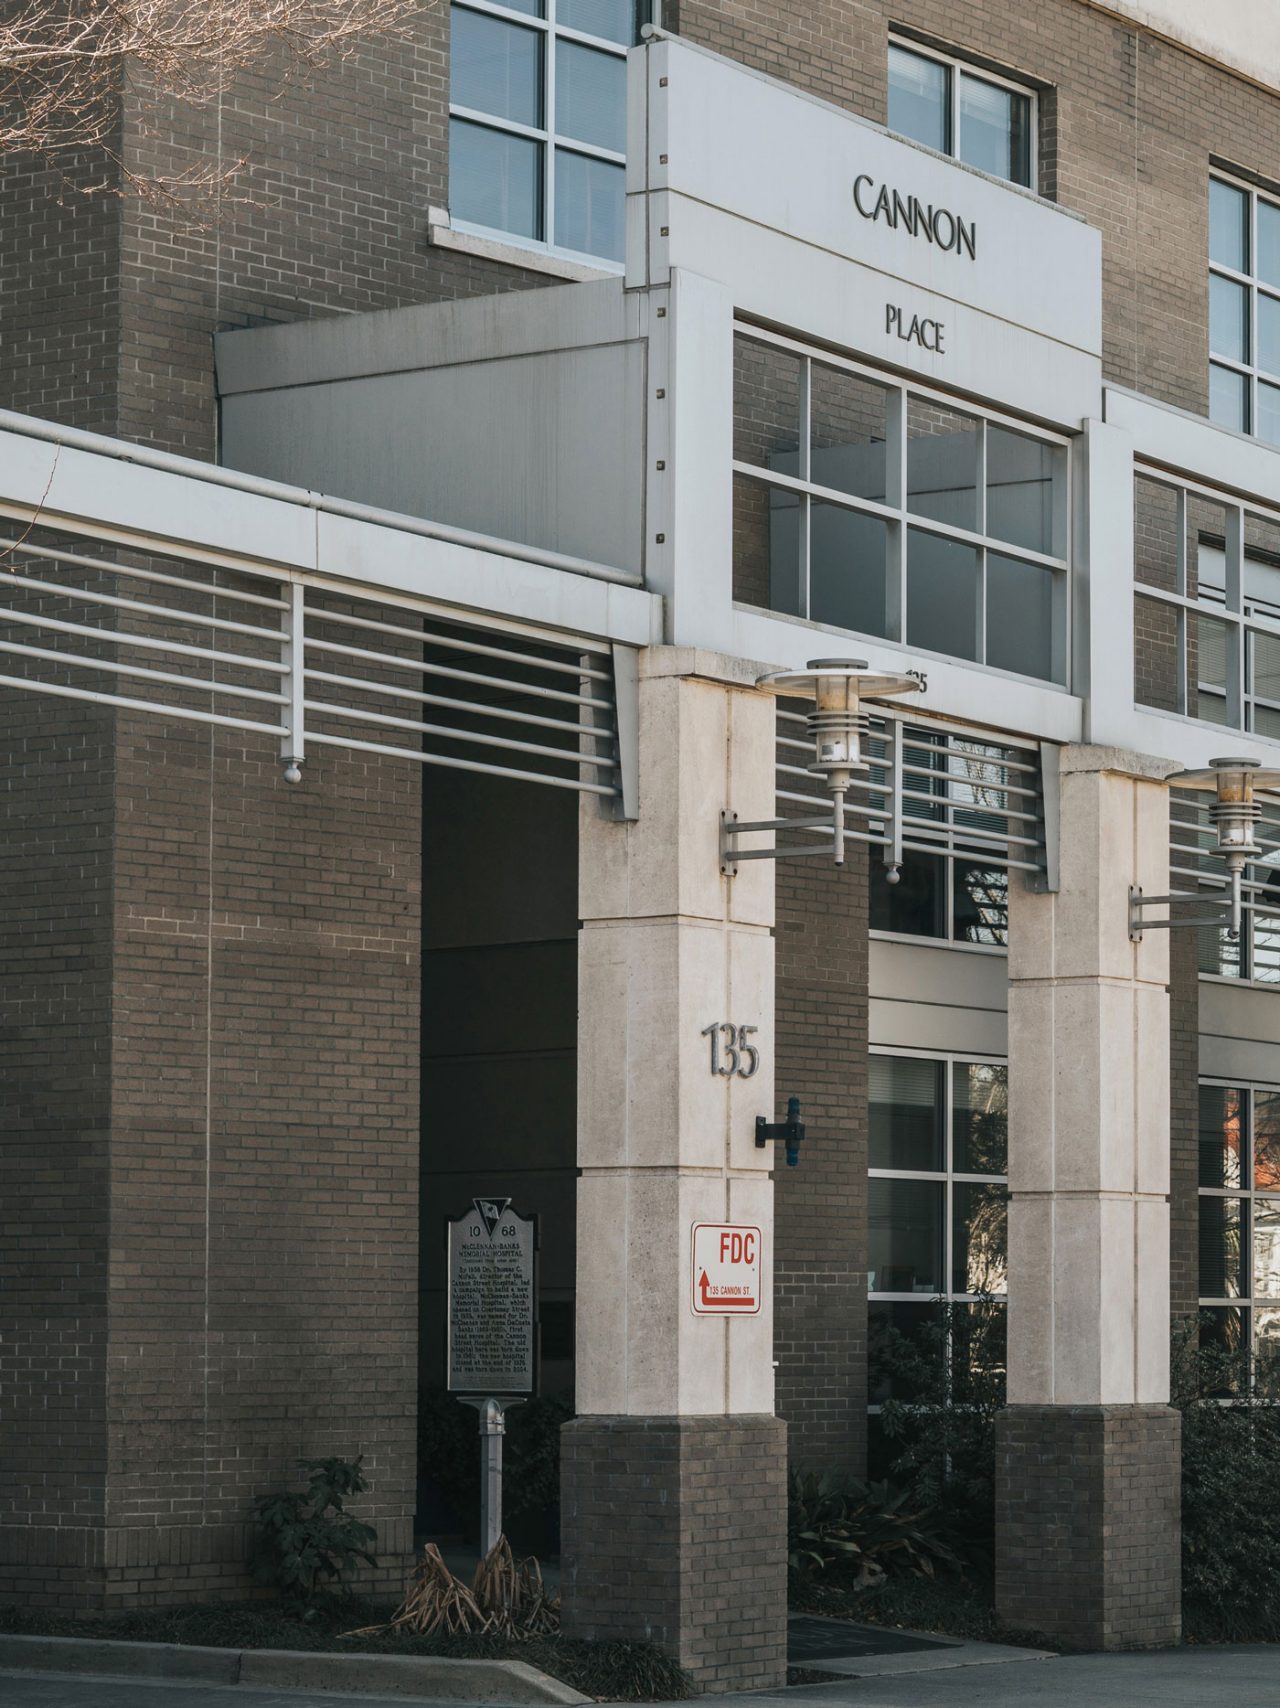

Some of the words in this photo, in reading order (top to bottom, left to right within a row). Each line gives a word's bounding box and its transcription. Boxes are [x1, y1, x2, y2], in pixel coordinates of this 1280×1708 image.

[853, 174, 976, 261] CANNON
[885, 303, 945, 355] PLACE
[701, 1022, 760, 1079] 135
[469, 1226, 481, 1237] 10
[501, 1225, 516, 1237] 68
[720, 1232, 755, 1265] FDC
[709, 1286, 719, 1295] 135
[720, 1286, 742, 1295] CANNON
